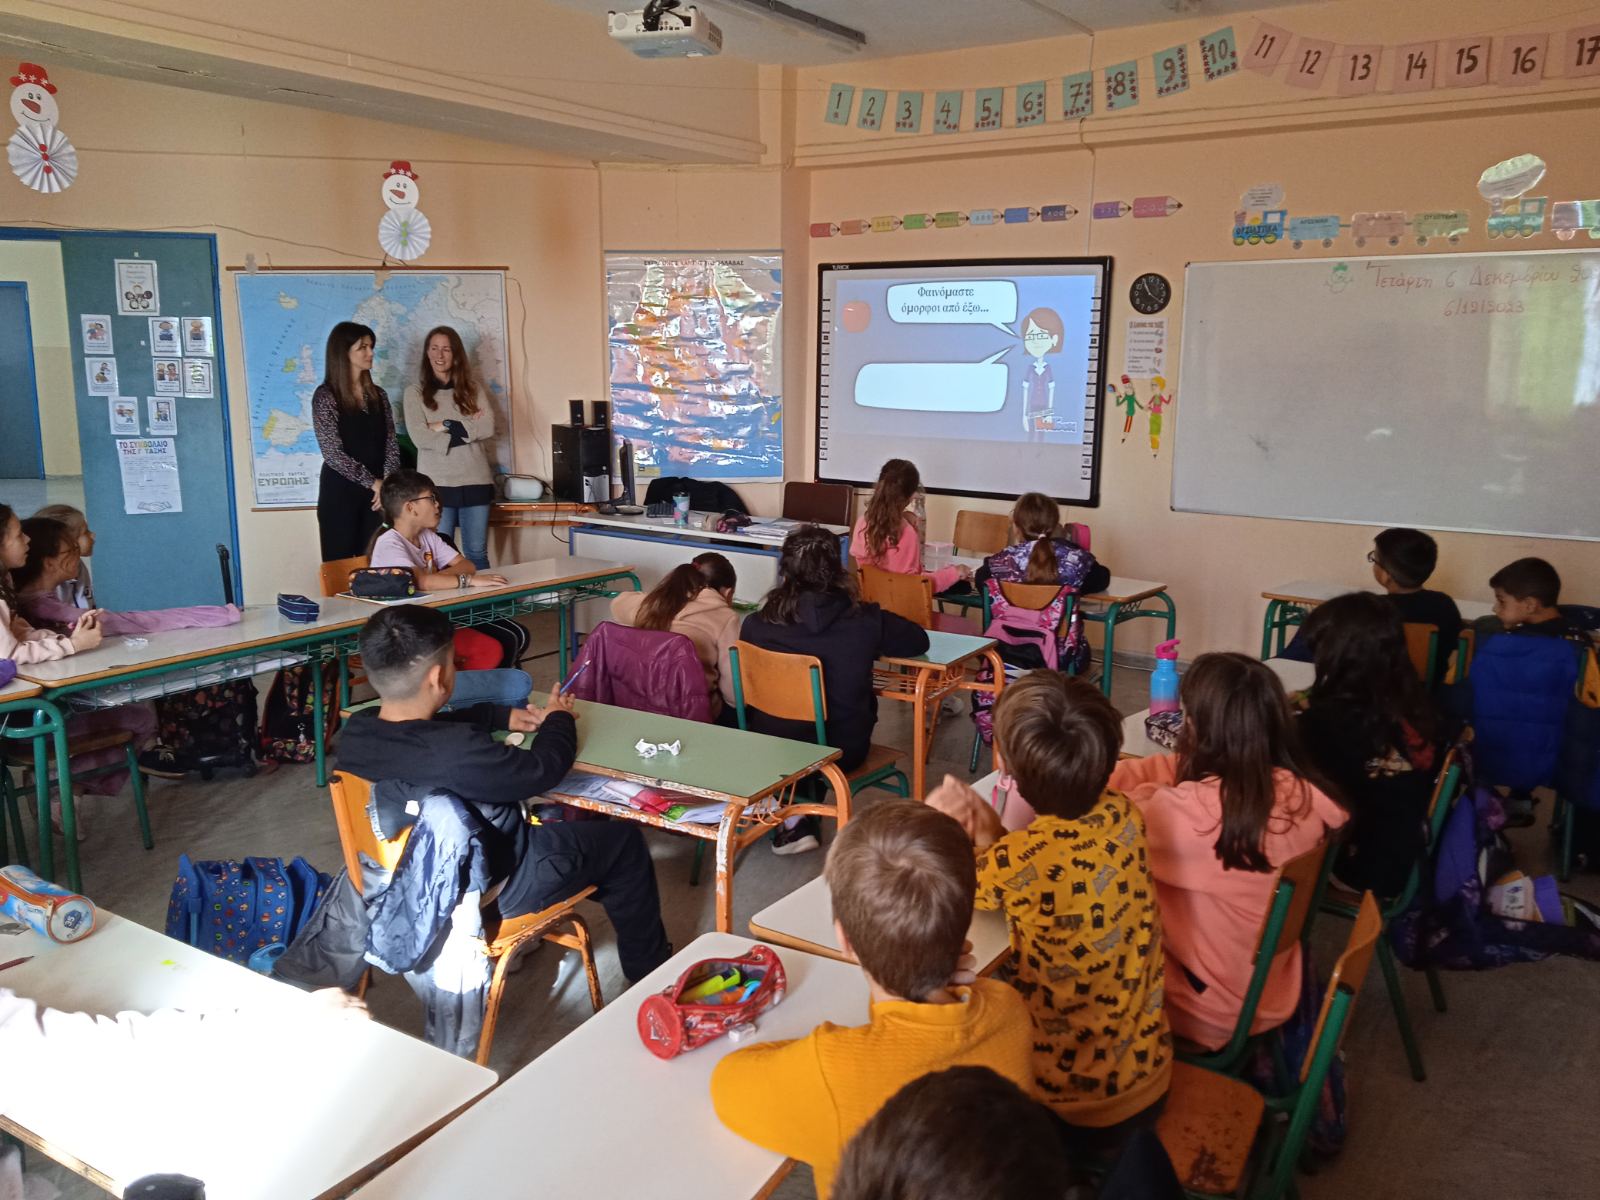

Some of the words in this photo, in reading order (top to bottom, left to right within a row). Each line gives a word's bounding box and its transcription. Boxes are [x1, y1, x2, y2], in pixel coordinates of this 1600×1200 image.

[1254, 33, 1276, 59] 11
[1299, 49, 1321, 75] 12
[1350, 53, 1371, 81] 13
[1405, 51, 1427, 80] 14
[1455, 45, 1480, 75] 15
[1512, 46, 1537, 74] 16
[1576, 35, 1600, 66] 17
[865, 97, 875, 117] 2
[902, 100, 912, 120] 3
[940, 99, 951, 119] 4
[981, 98, 993, 120] 5
[1023, 96, 1034, 113] 6
[1069, 81, 1084, 109] 7
[1112, 71, 1126, 97] 8
[1163, 57, 1176, 83] 9
[1208, 38, 1228, 64] 10
[1447, 270, 1456, 288] 6
[918, 286, 975, 300] Φαινόμαστε
[901, 302, 940, 315] όμορφοι
[942, 302, 961, 313] από
